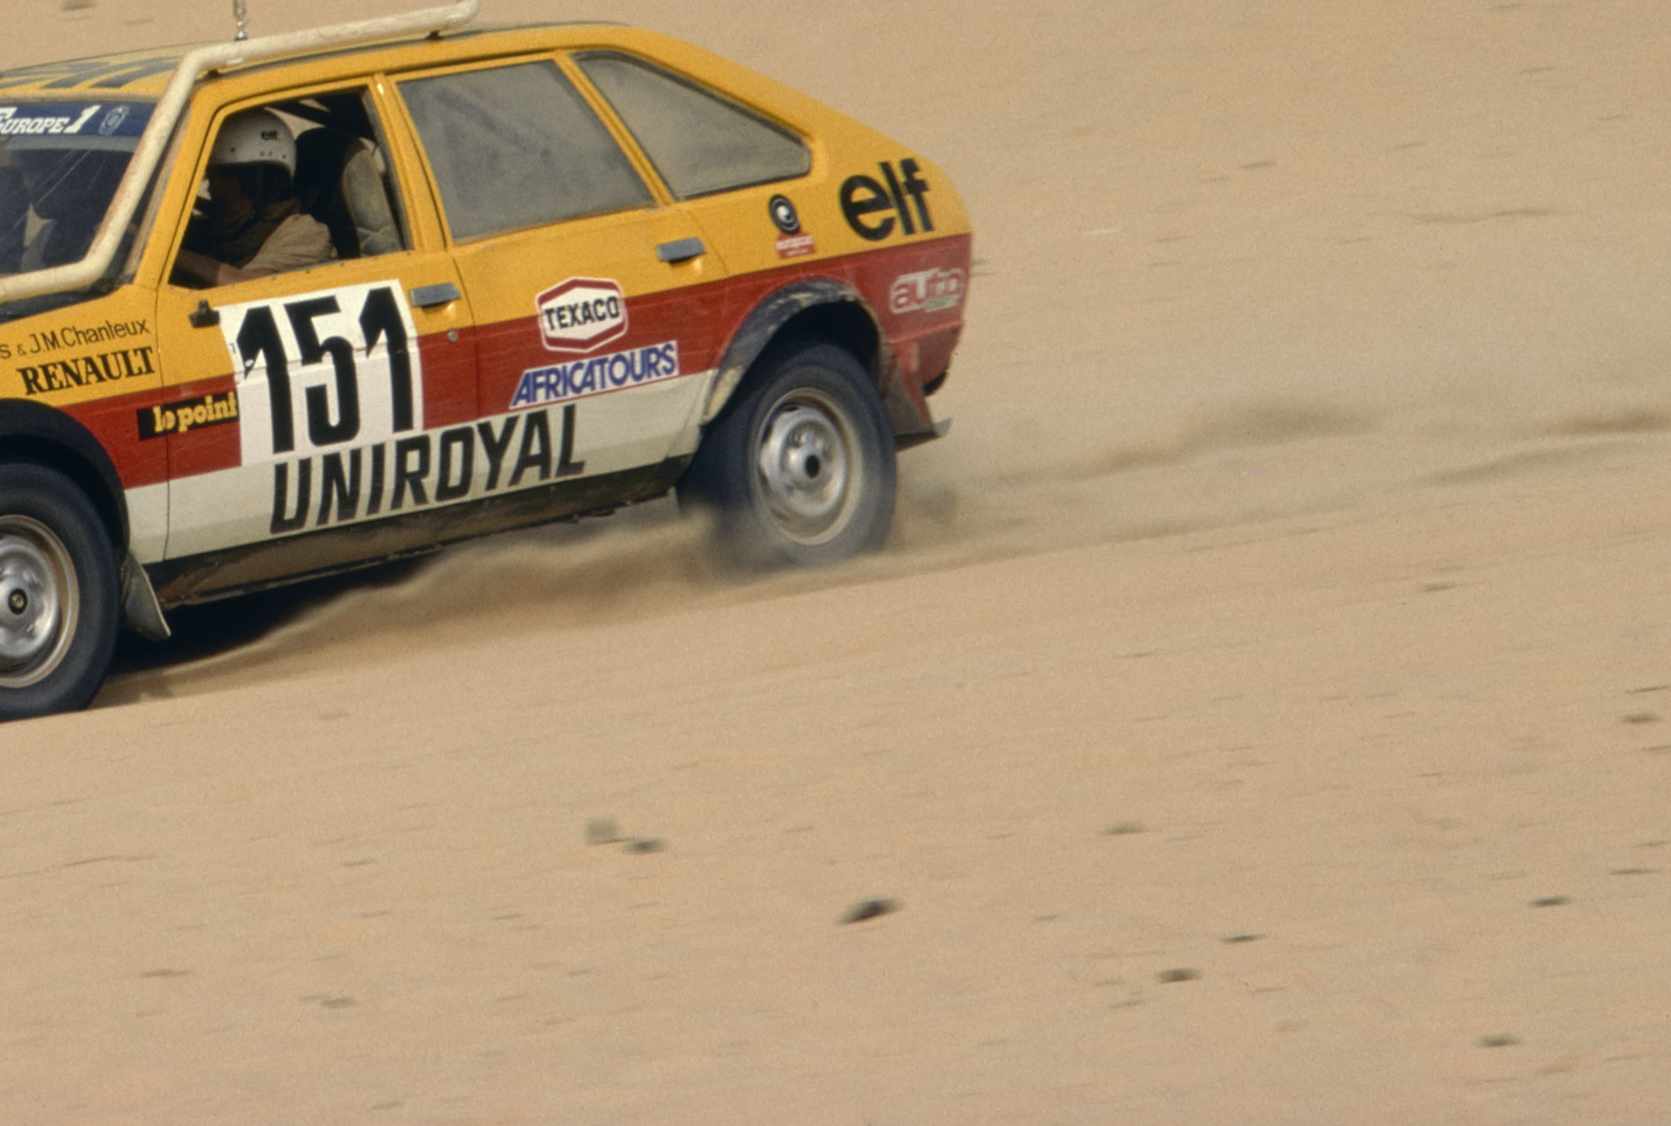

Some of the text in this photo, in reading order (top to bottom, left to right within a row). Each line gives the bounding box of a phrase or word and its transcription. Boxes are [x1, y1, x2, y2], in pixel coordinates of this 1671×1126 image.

[838, 157, 935, 242] elf
[544, 296, 620, 331] TEXACO
[16, 346, 155, 396] RENAULT
[236, 287, 415, 455] 151
[511, 343, 677, 406] AFRICATOURS
[152, 391, 237, 433] le point
[270, 404, 585, 534] UNIROYAL
